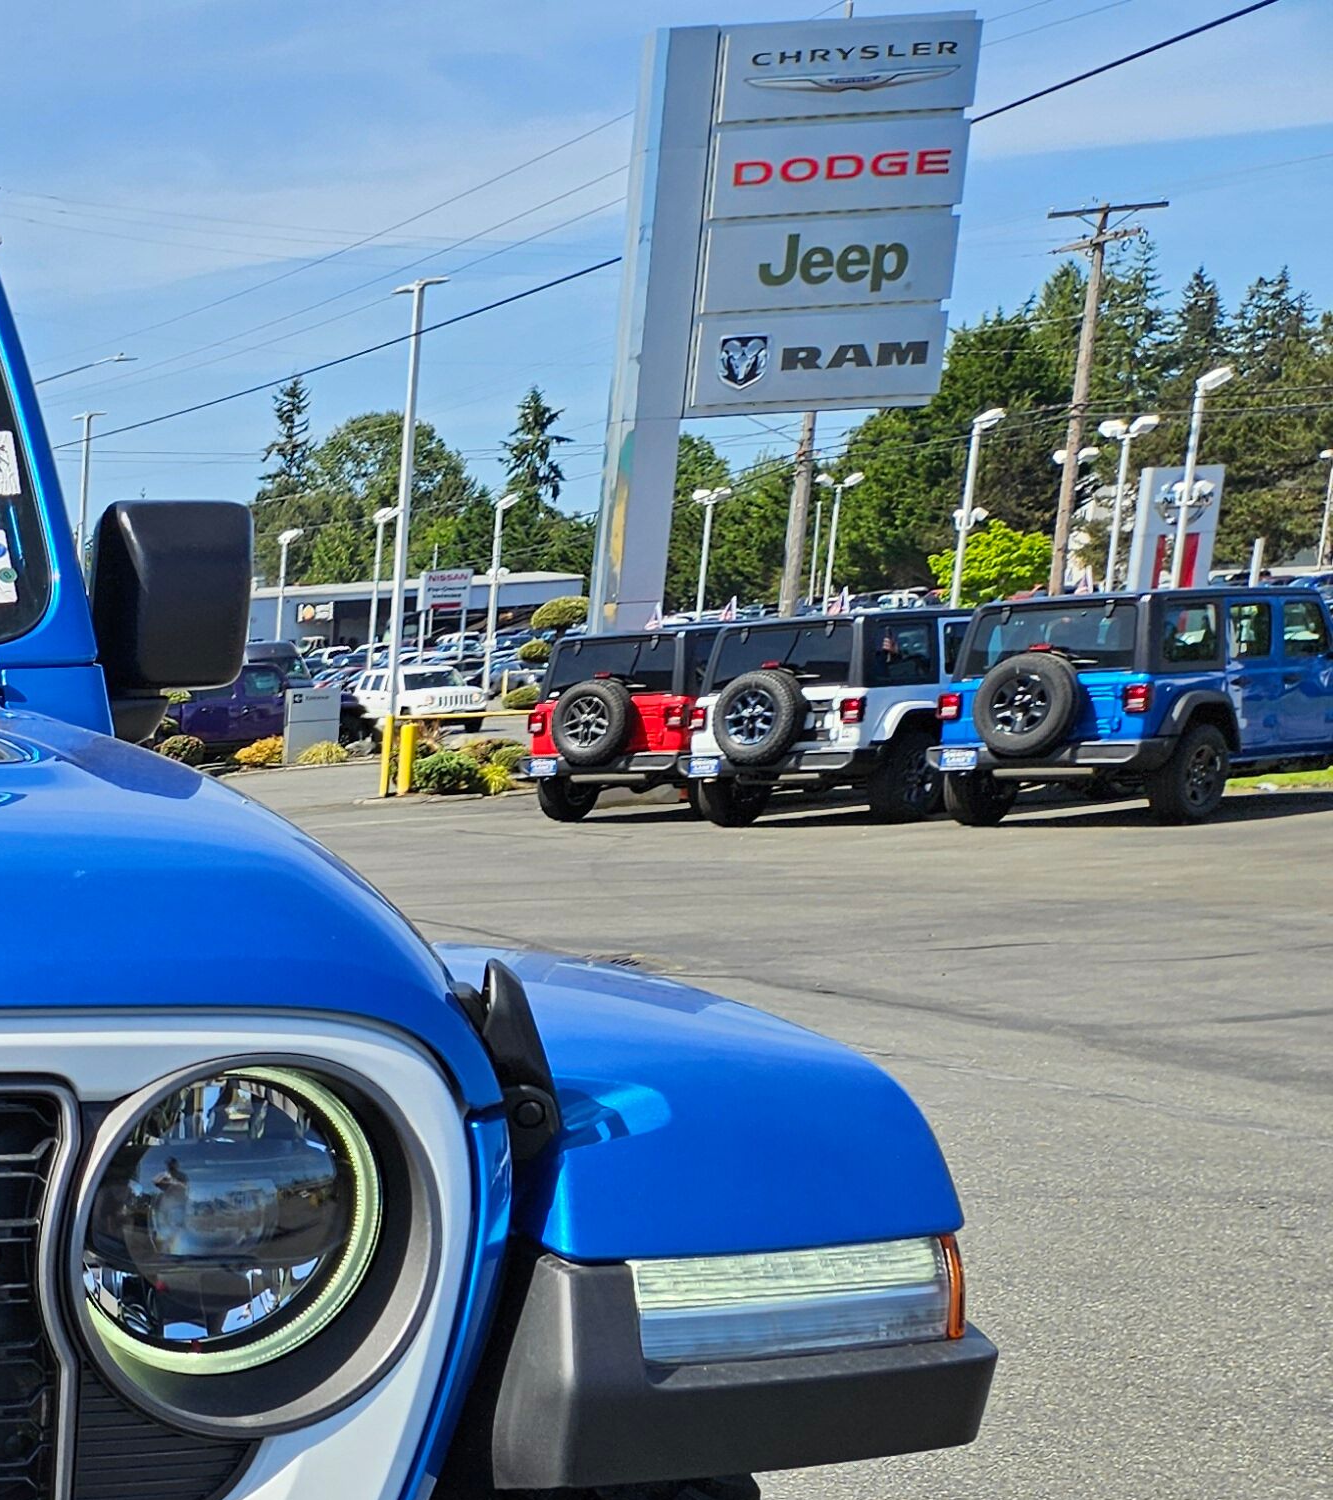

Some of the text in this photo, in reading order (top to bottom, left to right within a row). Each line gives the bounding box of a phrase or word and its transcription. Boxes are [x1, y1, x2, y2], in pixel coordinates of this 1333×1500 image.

[752, 41, 958, 66] CHRYSLER
[733, 149, 952, 187] DODGE
[758, 233, 909, 292] Jeep
[781, 340, 929, 371] RAM
